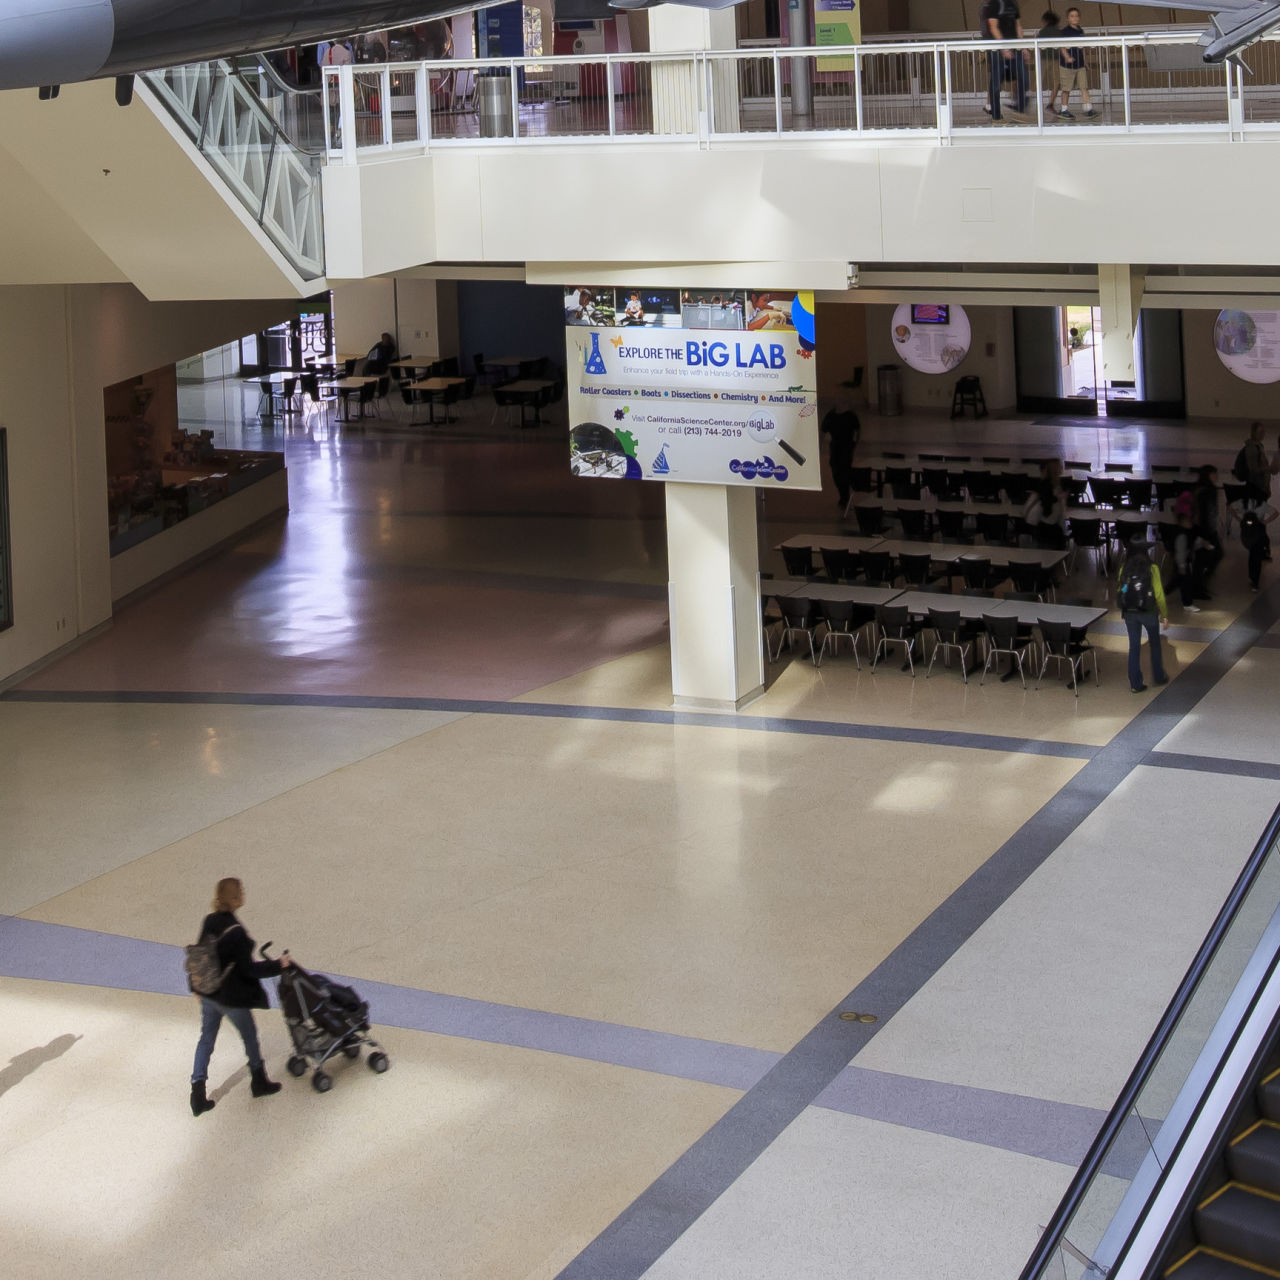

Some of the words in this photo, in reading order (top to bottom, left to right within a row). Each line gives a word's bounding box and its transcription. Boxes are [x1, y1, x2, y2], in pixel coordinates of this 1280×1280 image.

[618, 346, 664, 359] EXPLORE
[664, 348, 684, 360] THE
[735, 342, 787, 370] LAB
[623, 366, 649, 374] Enhance
[649, 368, 664, 376] your
[709, 370, 743, 378] Hands-On
[744, 371, 779, 380] Experience
[580, 386, 601, 395] Roller
[602, 387, 632, 396] Coasters
[641, 389, 662, 397] Boats
[671, 390, 712, 400] Dissections
[721, 392, 759, 404] Chemistry
[768, 394, 784, 402] And
[785, 395, 807, 404] More!
[668, 426, 682, 434] call
[683, 426, 702, 436] (213)
[704, 427, 742, 437] 744-2019
